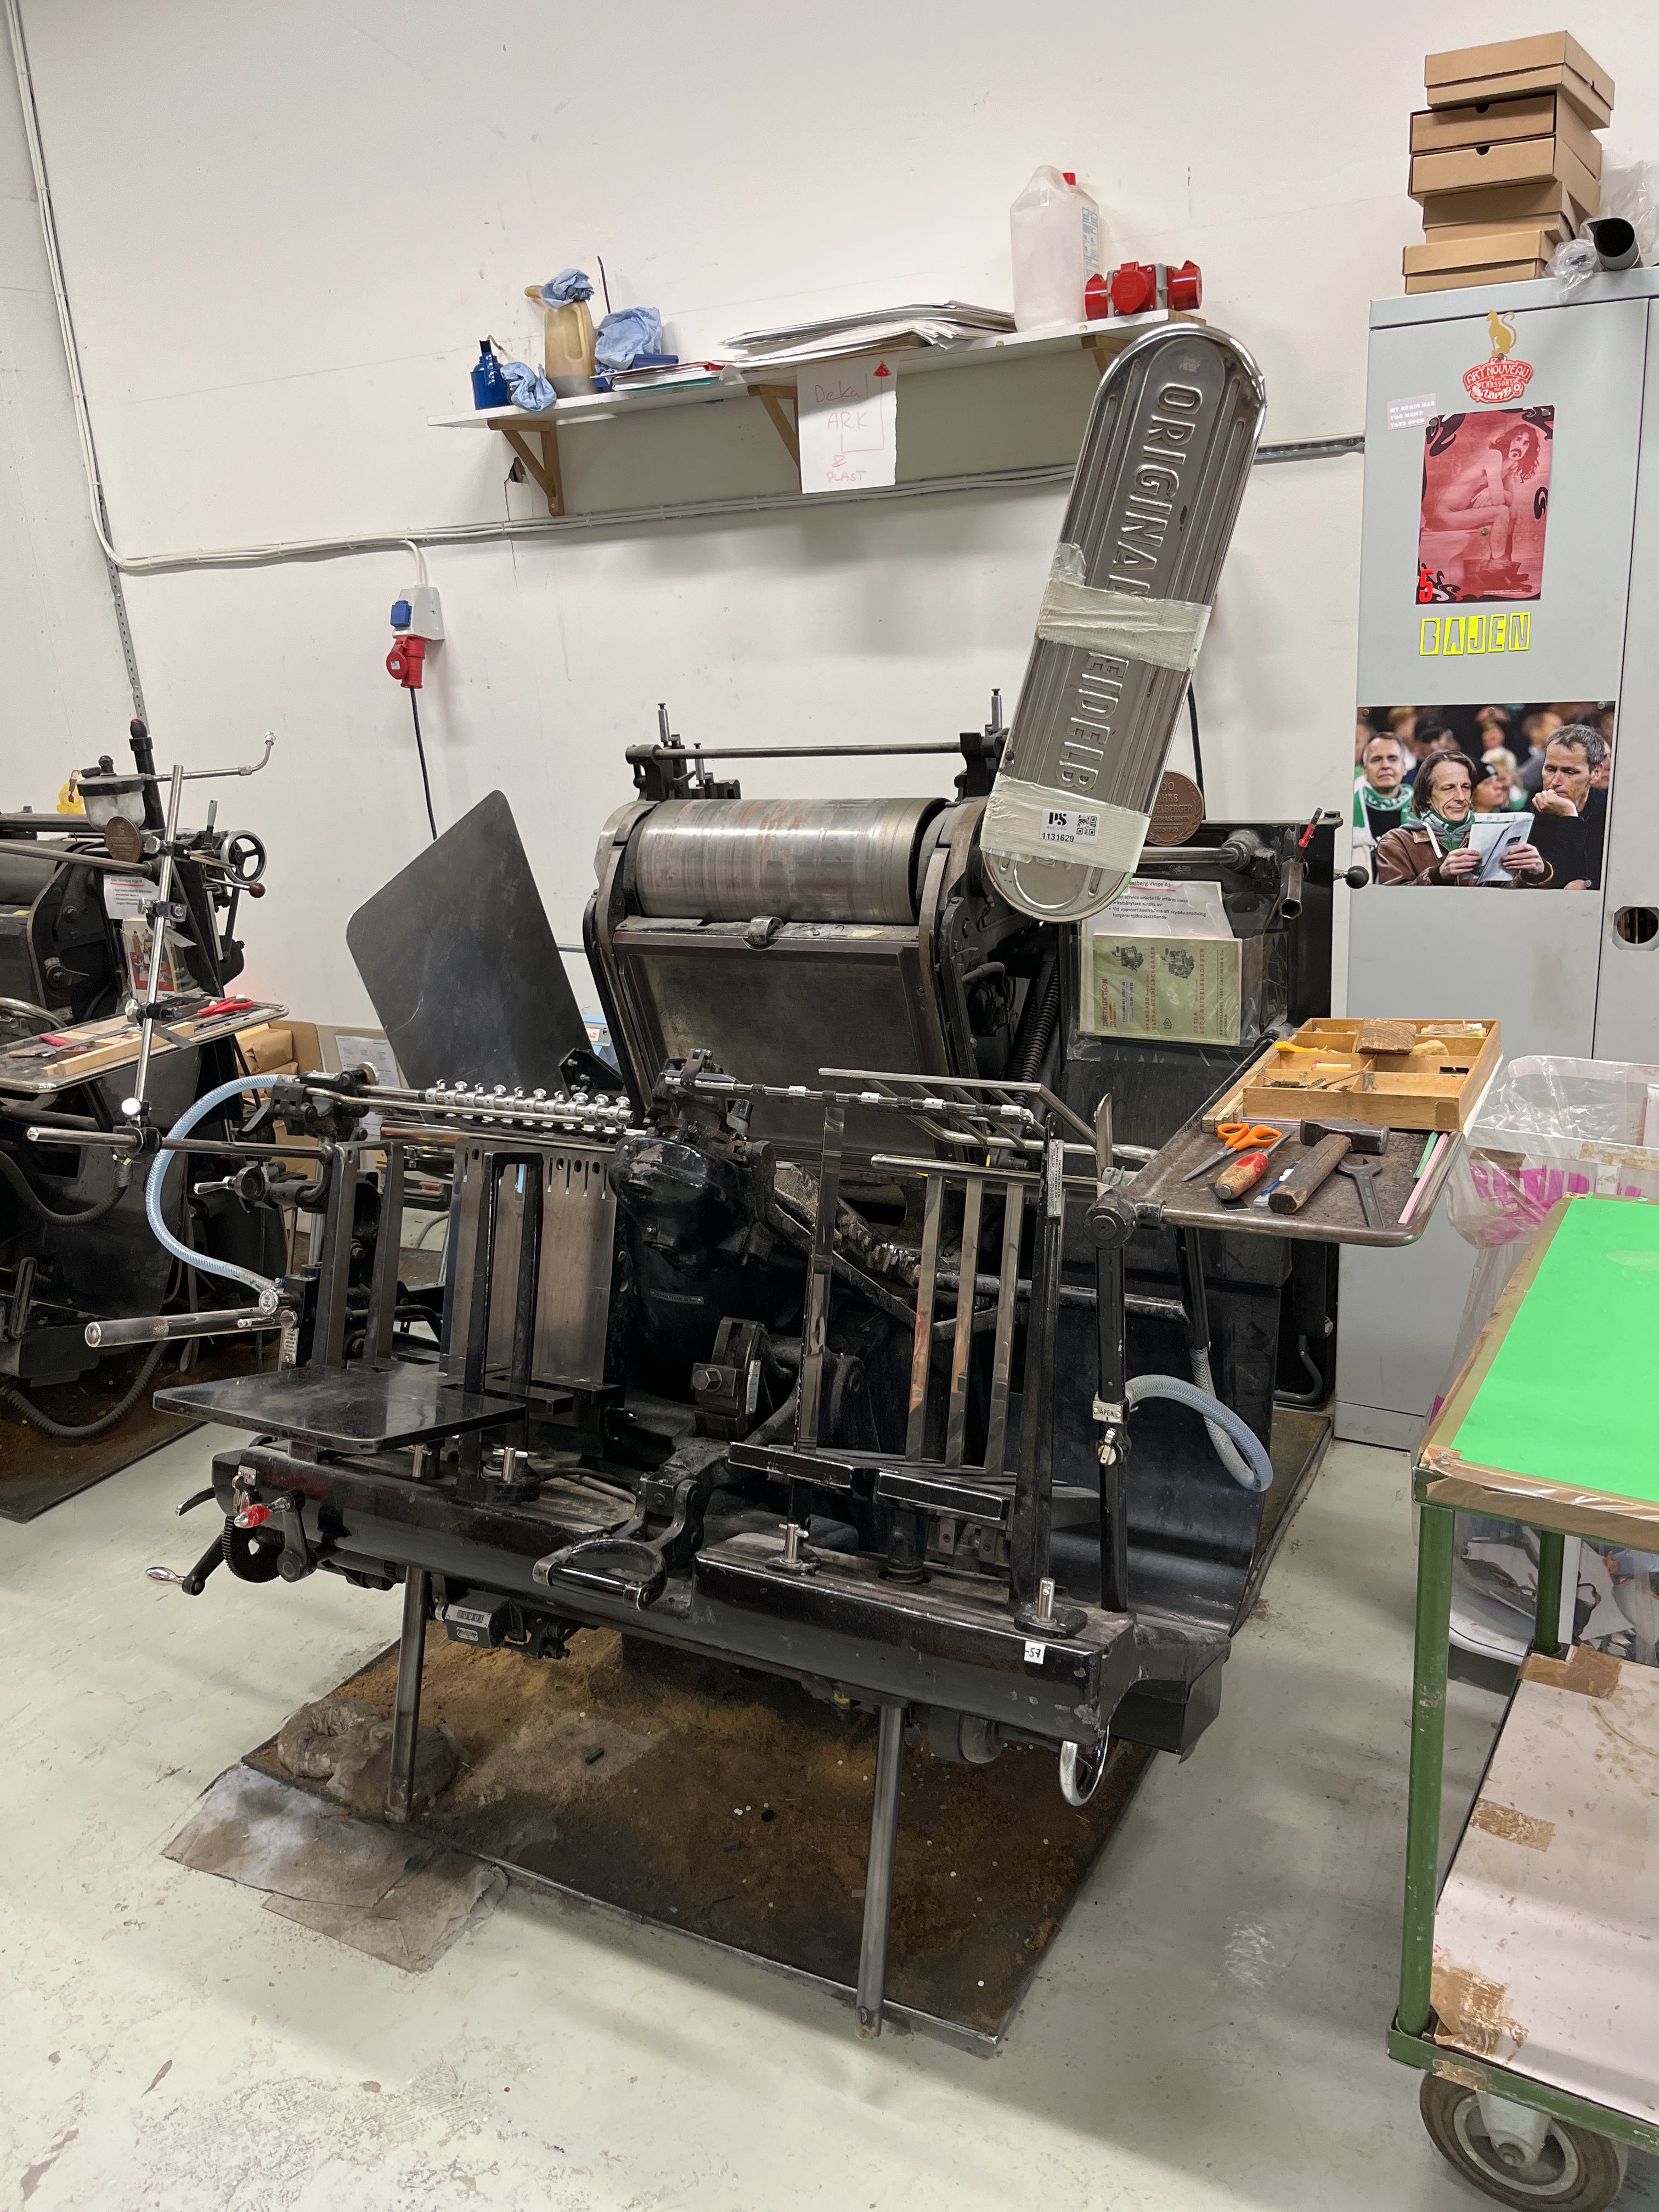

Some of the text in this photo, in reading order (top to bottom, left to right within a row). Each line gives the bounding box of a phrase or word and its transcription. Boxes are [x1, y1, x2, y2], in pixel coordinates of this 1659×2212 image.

[1466, 364, 1530, 384] ART NOUVEAU
[828, 411, 868, 431] ARK
[1419, 569, 1434, 602] 5
[1420, 612, 1530, 655] BAJEN
[1160, 782, 1175, 791] 00
[1157, 793, 1179, 803] AHRE
[1042, 833, 1074, 843] 1131629
